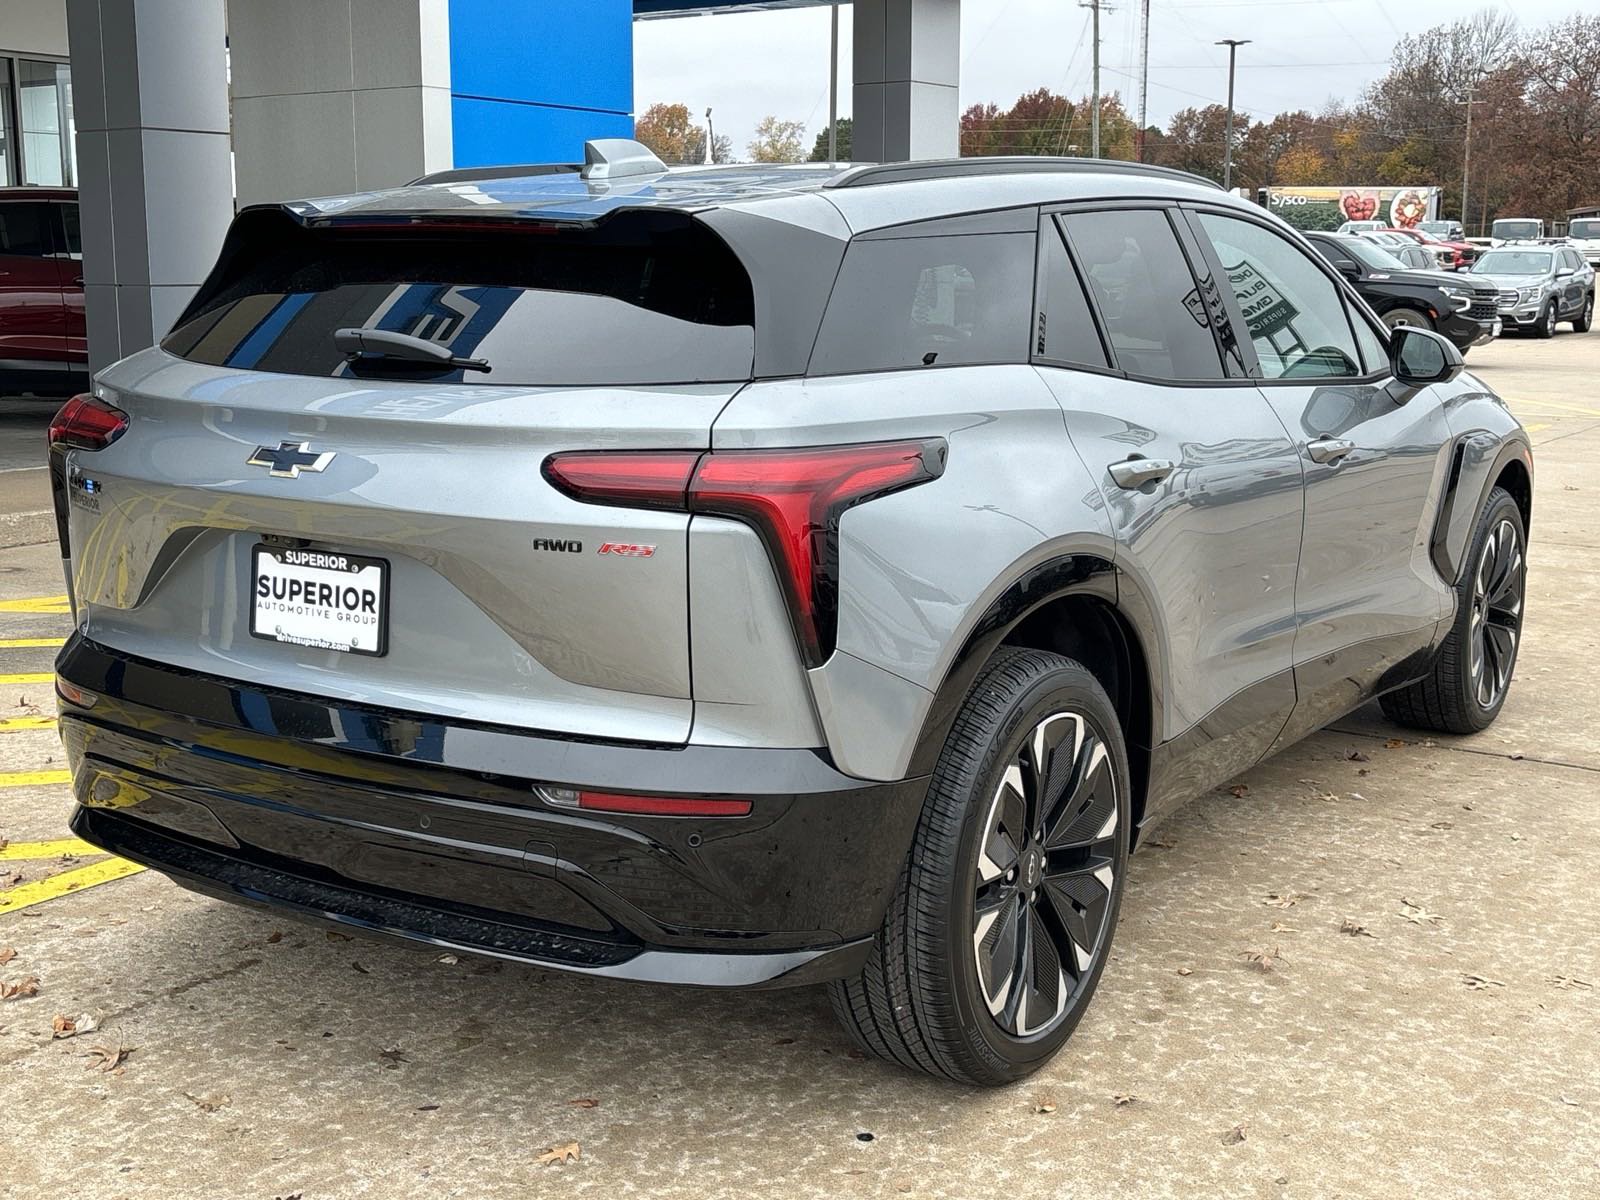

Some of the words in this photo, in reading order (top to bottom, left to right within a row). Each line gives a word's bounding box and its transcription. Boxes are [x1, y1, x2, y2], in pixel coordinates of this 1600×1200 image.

[1271, 192, 1307, 208] Sysco
[533, 538, 582, 553] AWD
[597, 542, 657, 558] RS
[285, 550, 348, 570] SUPERIOR
[257, 574, 376, 614] SUPERIOR
[257, 600, 330, 619] AUTOMOTIVE
[336, 612, 377, 625] GROUP
